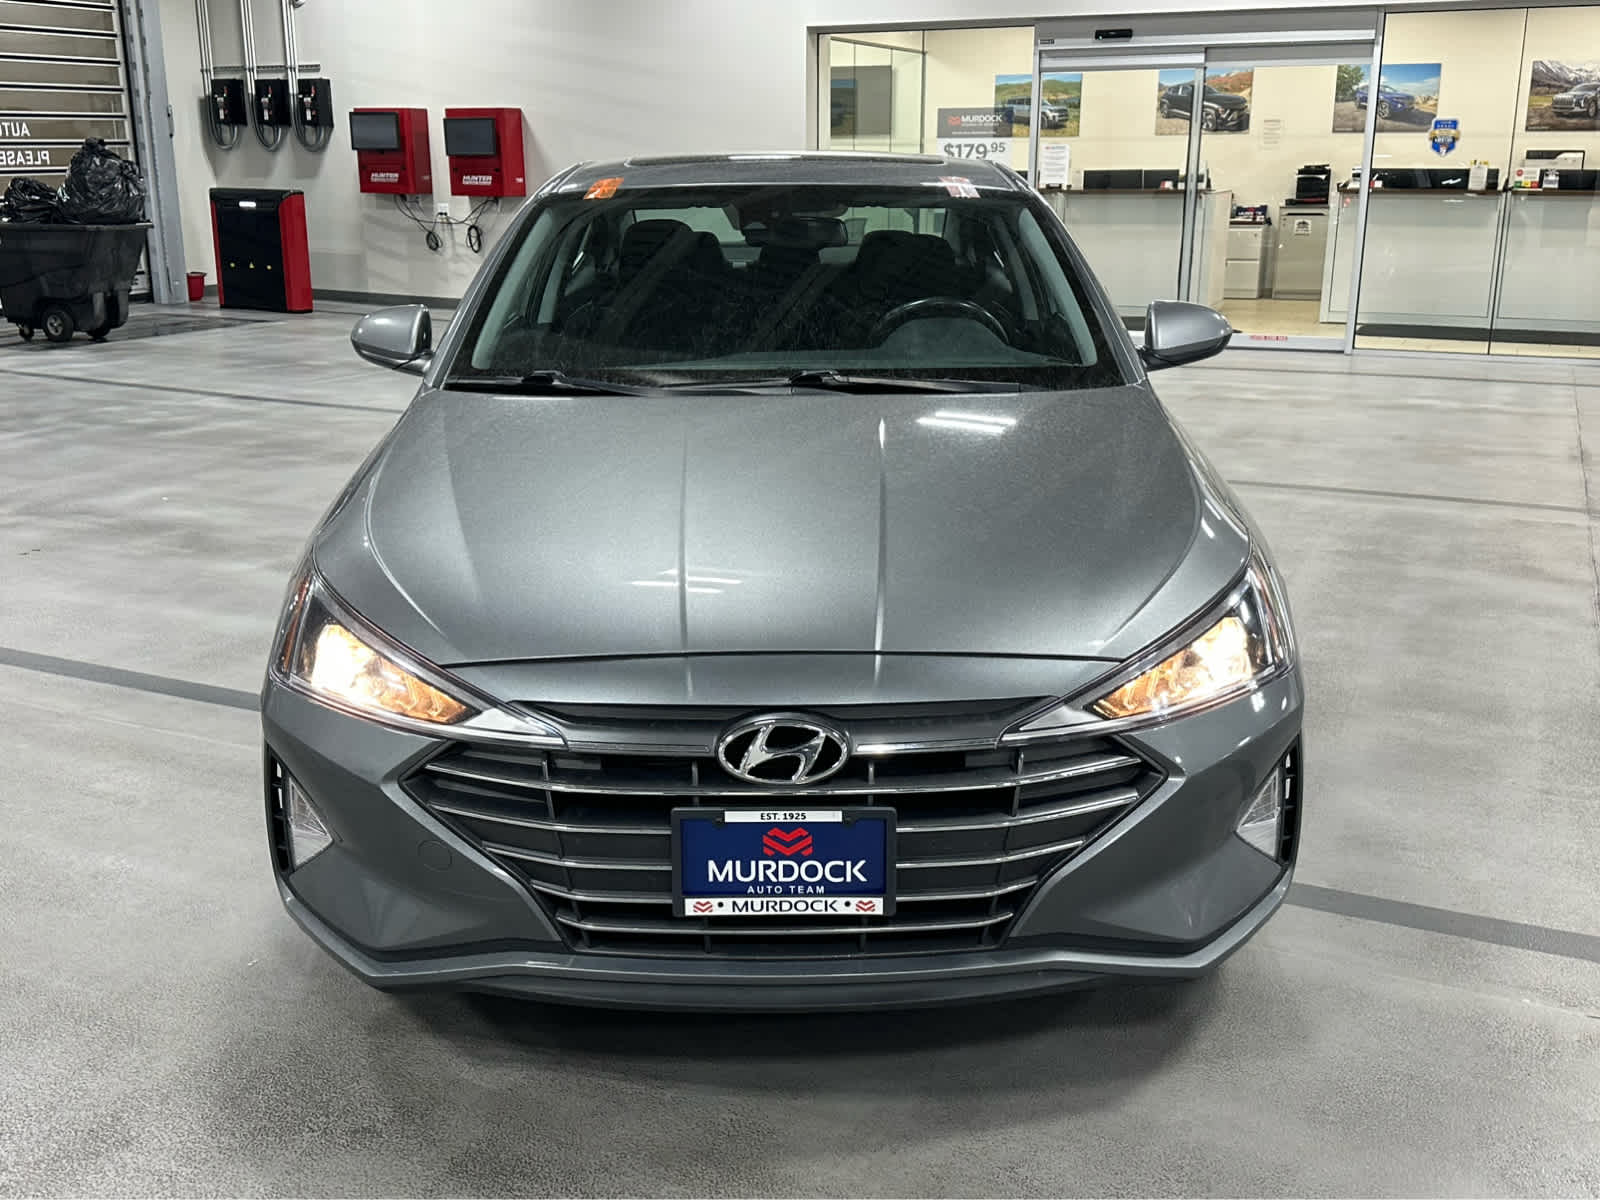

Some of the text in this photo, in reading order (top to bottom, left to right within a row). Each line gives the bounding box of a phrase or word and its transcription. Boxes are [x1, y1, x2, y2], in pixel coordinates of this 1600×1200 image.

[961, 114, 1002, 123] MURDOCK
[760, 812, 807, 821] EST. 1925
[707, 859, 867, 883] MURDOCK
[747, 885, 825, 895] AUTO TEAM
[732, 899, 839, 912] MURDOCK
